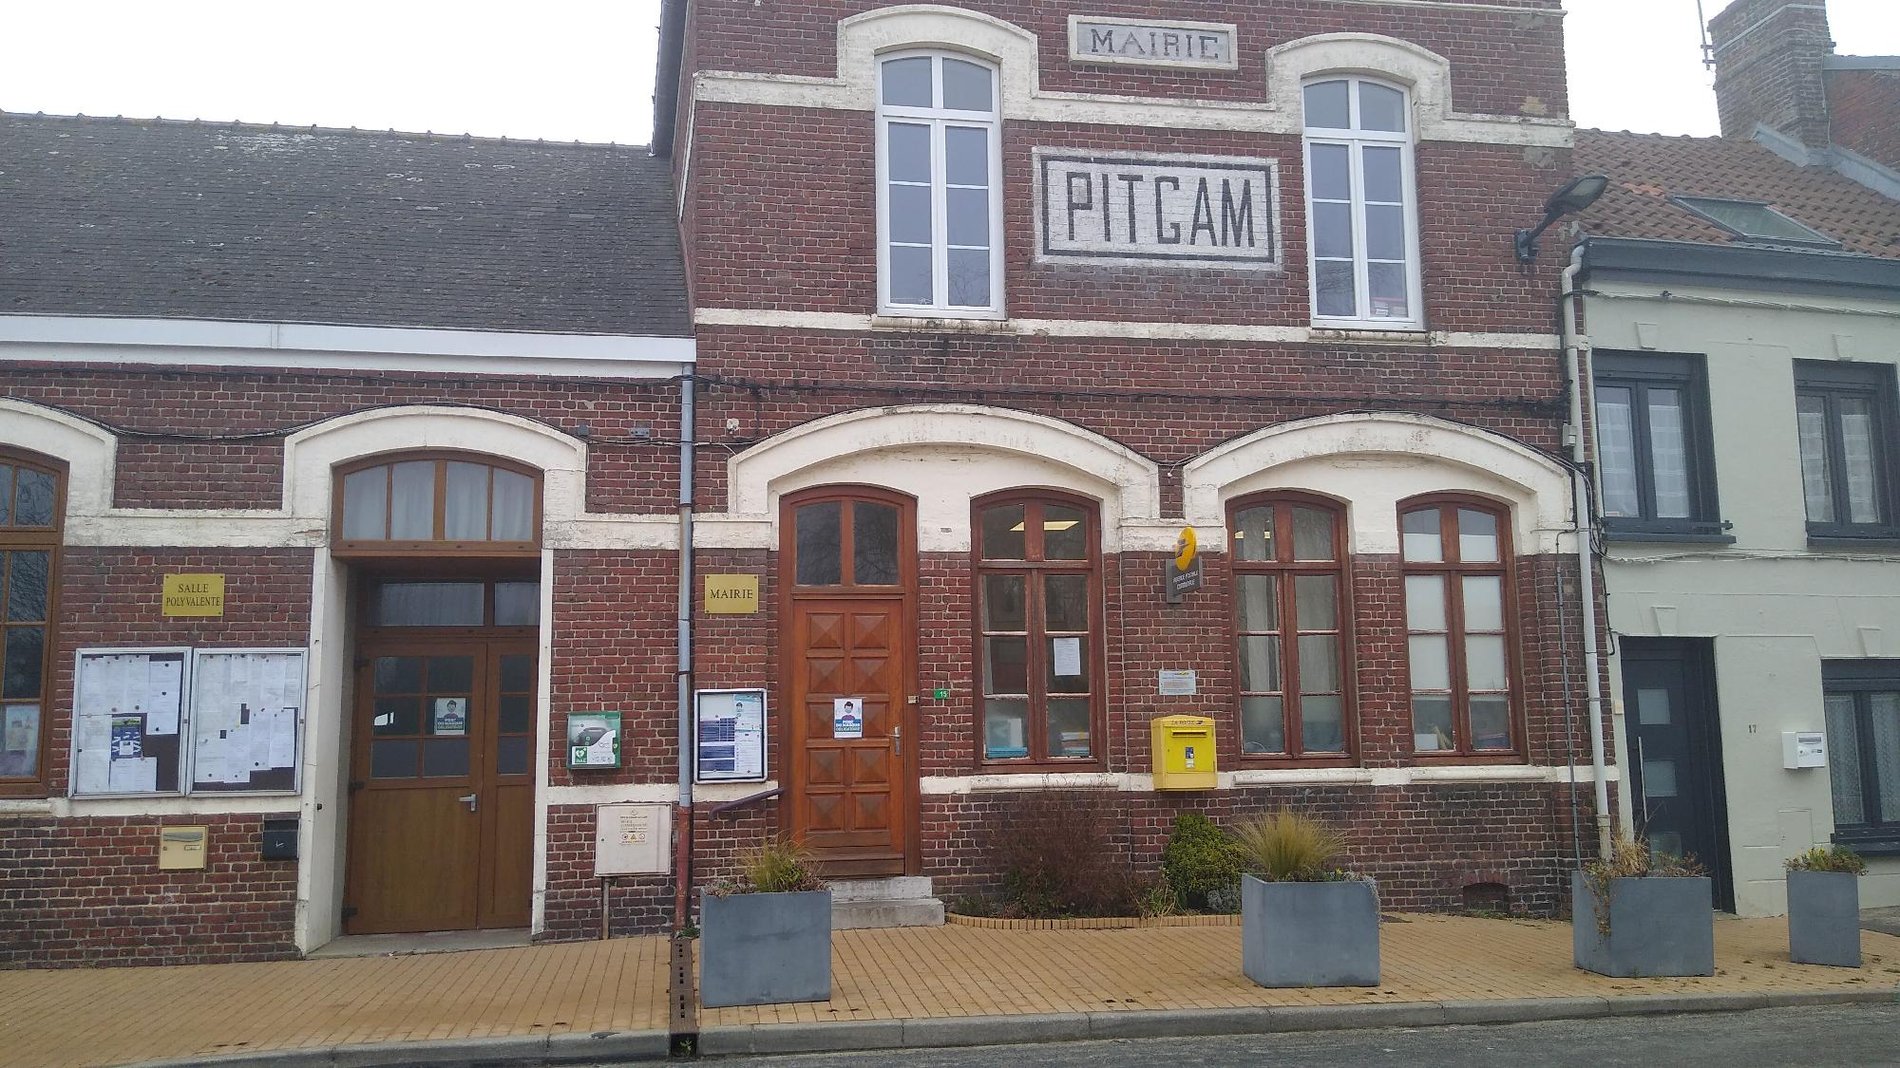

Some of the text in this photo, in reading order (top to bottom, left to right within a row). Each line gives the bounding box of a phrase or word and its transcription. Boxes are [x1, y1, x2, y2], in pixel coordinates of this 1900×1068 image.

[1090, 27, 1219, 60] MAIRIE
[1066, 171, 1255, 249] PITGAM
[178, 583, 209, 593] SALLE
[710, 588, 753, 599] MAIRIE
[166, 596, 221, 607] POLYVALENTE
[1748, 724, 1757, 734] 17
